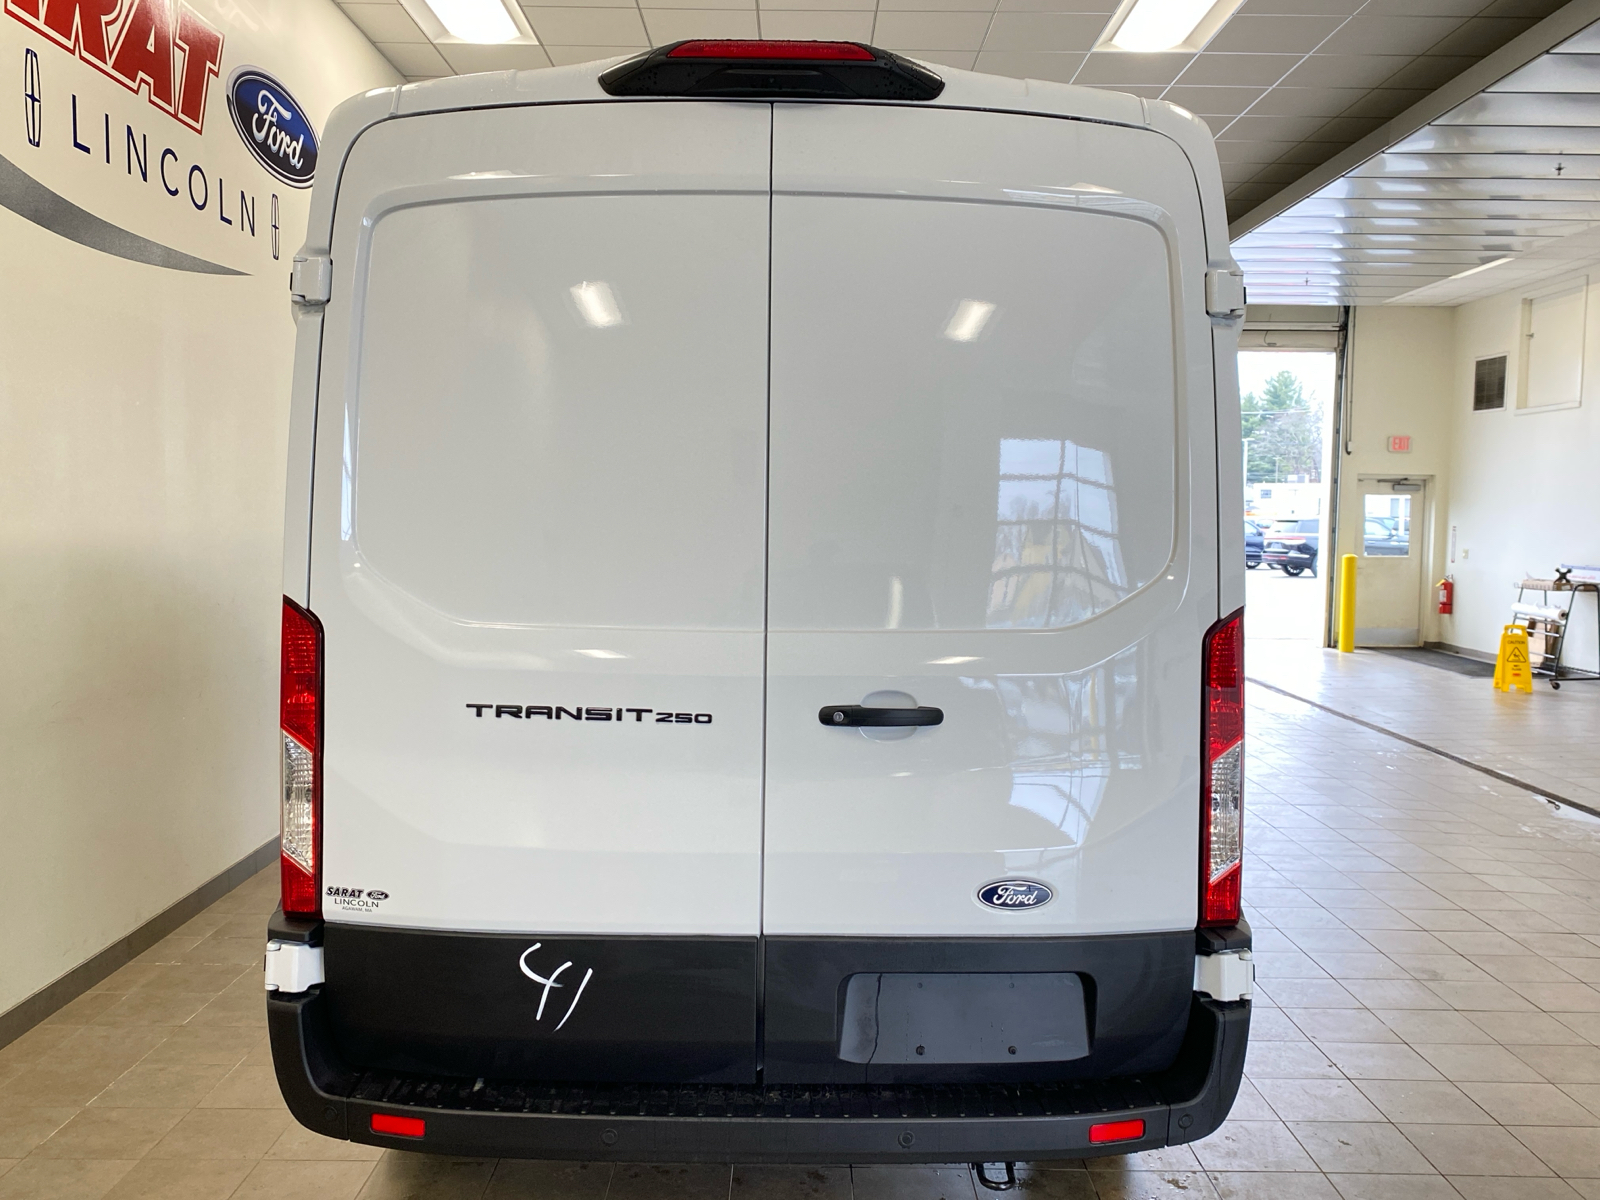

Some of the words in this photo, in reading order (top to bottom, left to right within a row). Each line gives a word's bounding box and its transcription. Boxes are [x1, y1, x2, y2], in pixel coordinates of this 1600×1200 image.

[252, 89, 304, 170] Ford
[72, 94, 255, 237] LINCOLN
[1392, 436, 1411, 451] EXIT
[466, 703, 653, 722] TRANSIT
[655, 712, 713, 724] 250
[326, 886, 364, 898] SARAT
[993, 885, 1037, 904] Ford
[334, 898, 379, 908] LINCOLN
[519, 942, 594, 1034] 41
